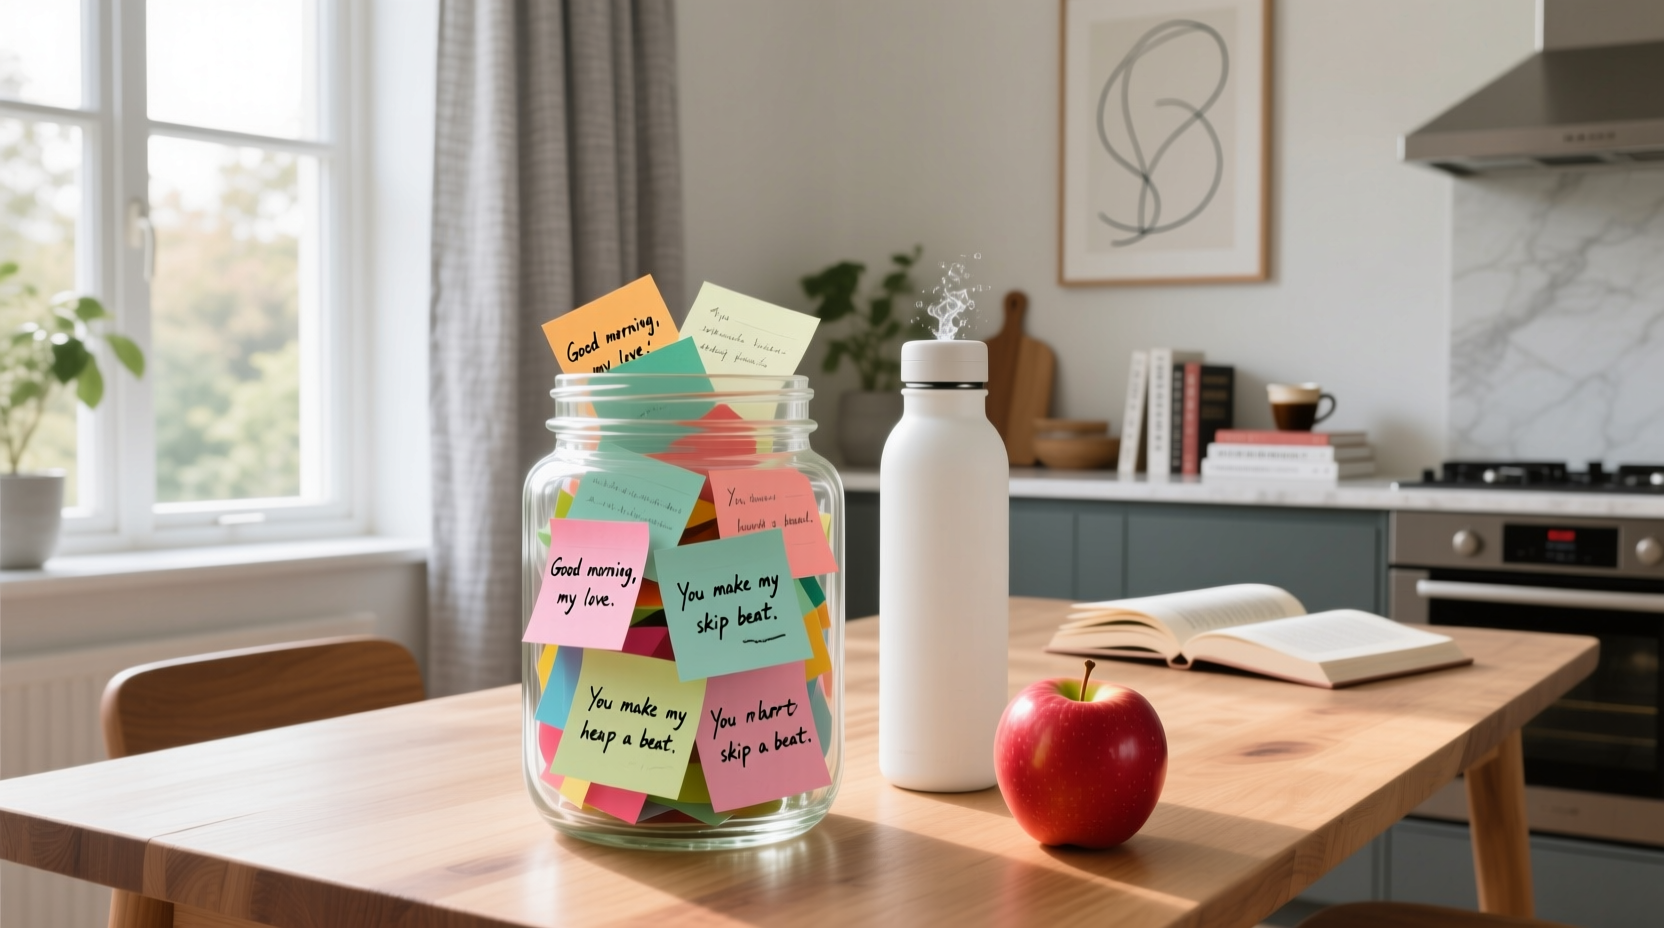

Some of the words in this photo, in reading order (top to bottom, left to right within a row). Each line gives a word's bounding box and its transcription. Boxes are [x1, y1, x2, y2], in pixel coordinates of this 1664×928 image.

[550, 556, 583, 577] Good
[556, 593, 577, 616] my
[584, 587, 614, 607] love.
[677, 581, 704, 612] You
[713, 573, 751, 598] make
[758, 574, 779, 599] my
[697, 612, 729, 641] skip
[738, 602, 777, 627] beat.
[587, 685, 613, 712] You
[619, 696, 658, 717] make
[665, 709, 687, 731] my
[710, 707, 737, 740] You
[622, 734, 632, 745] a
[639, 727, 675, 754] beat.
[720, 740, 751, 769] skip
[758, 742, 769, 754] a
[774, 726, 812, 751] beat.
